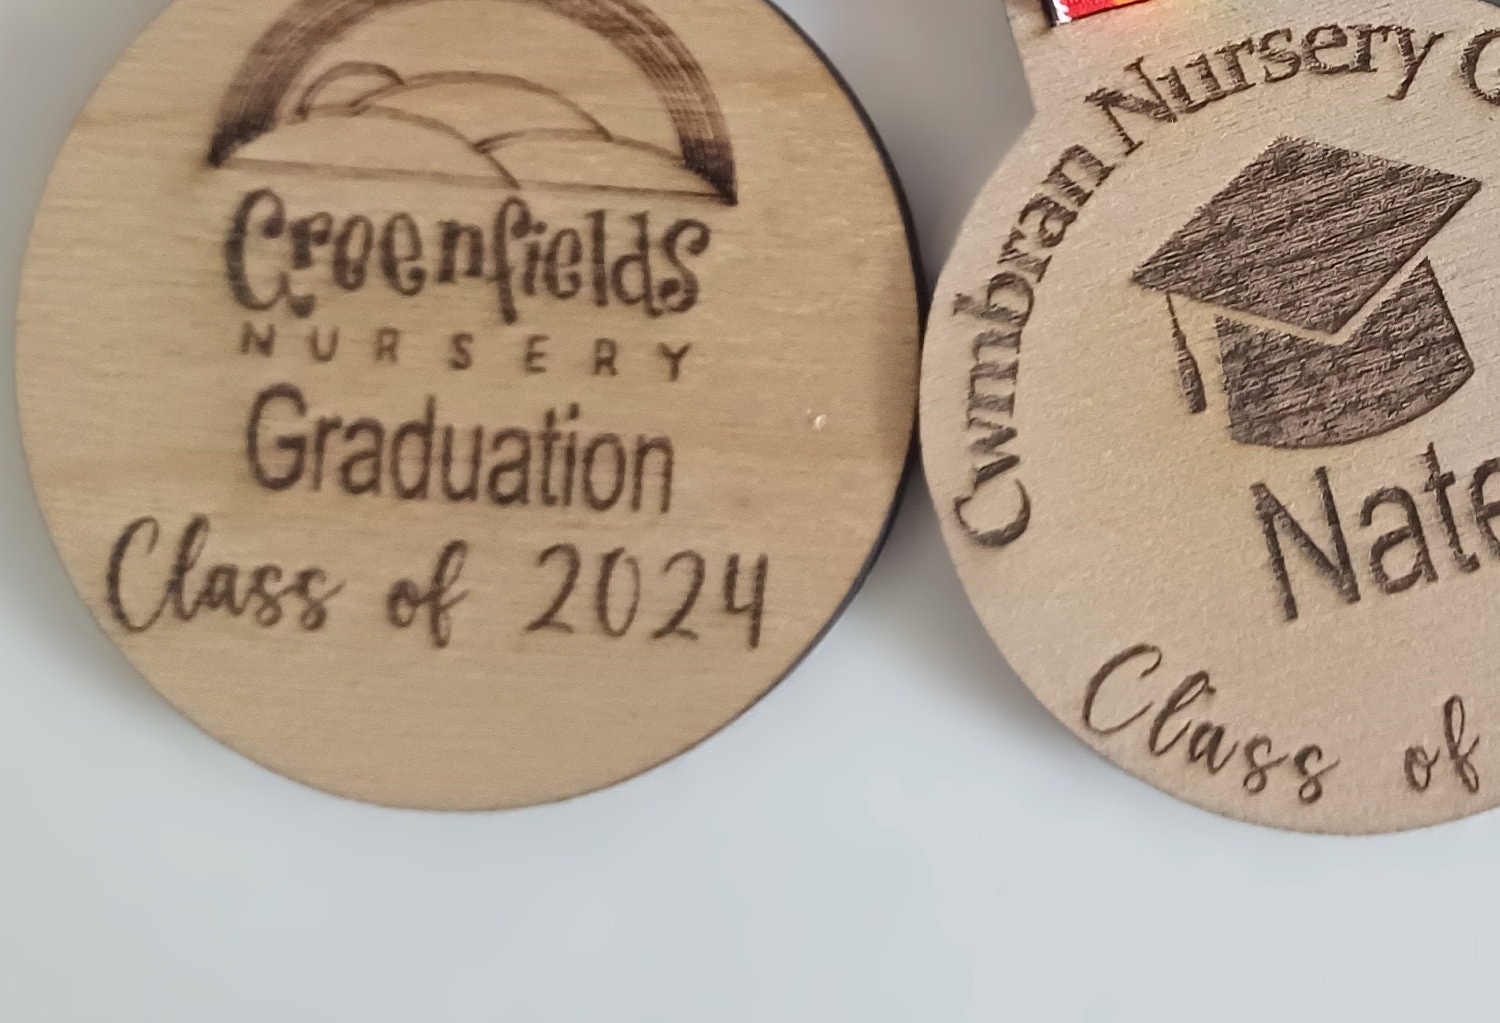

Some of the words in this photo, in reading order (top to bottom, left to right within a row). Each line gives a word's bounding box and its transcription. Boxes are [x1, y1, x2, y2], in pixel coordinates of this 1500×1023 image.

[224, 187, 711, 324] Greenfields
[953, 144, 1117, 548] Cwmbran
[1085, 23, 1446, 154] Nursery
[239, 320, 692, 381] NURSERY
[246, 383, 673, 514] Graduation
[106, 515, 343, 634] Class
[387, 540, 471, 648] of
[525, 542, 770, 649] 2024
[1081, 644, 1340, 803] Class
[1403, 694, 1481, 793] of
